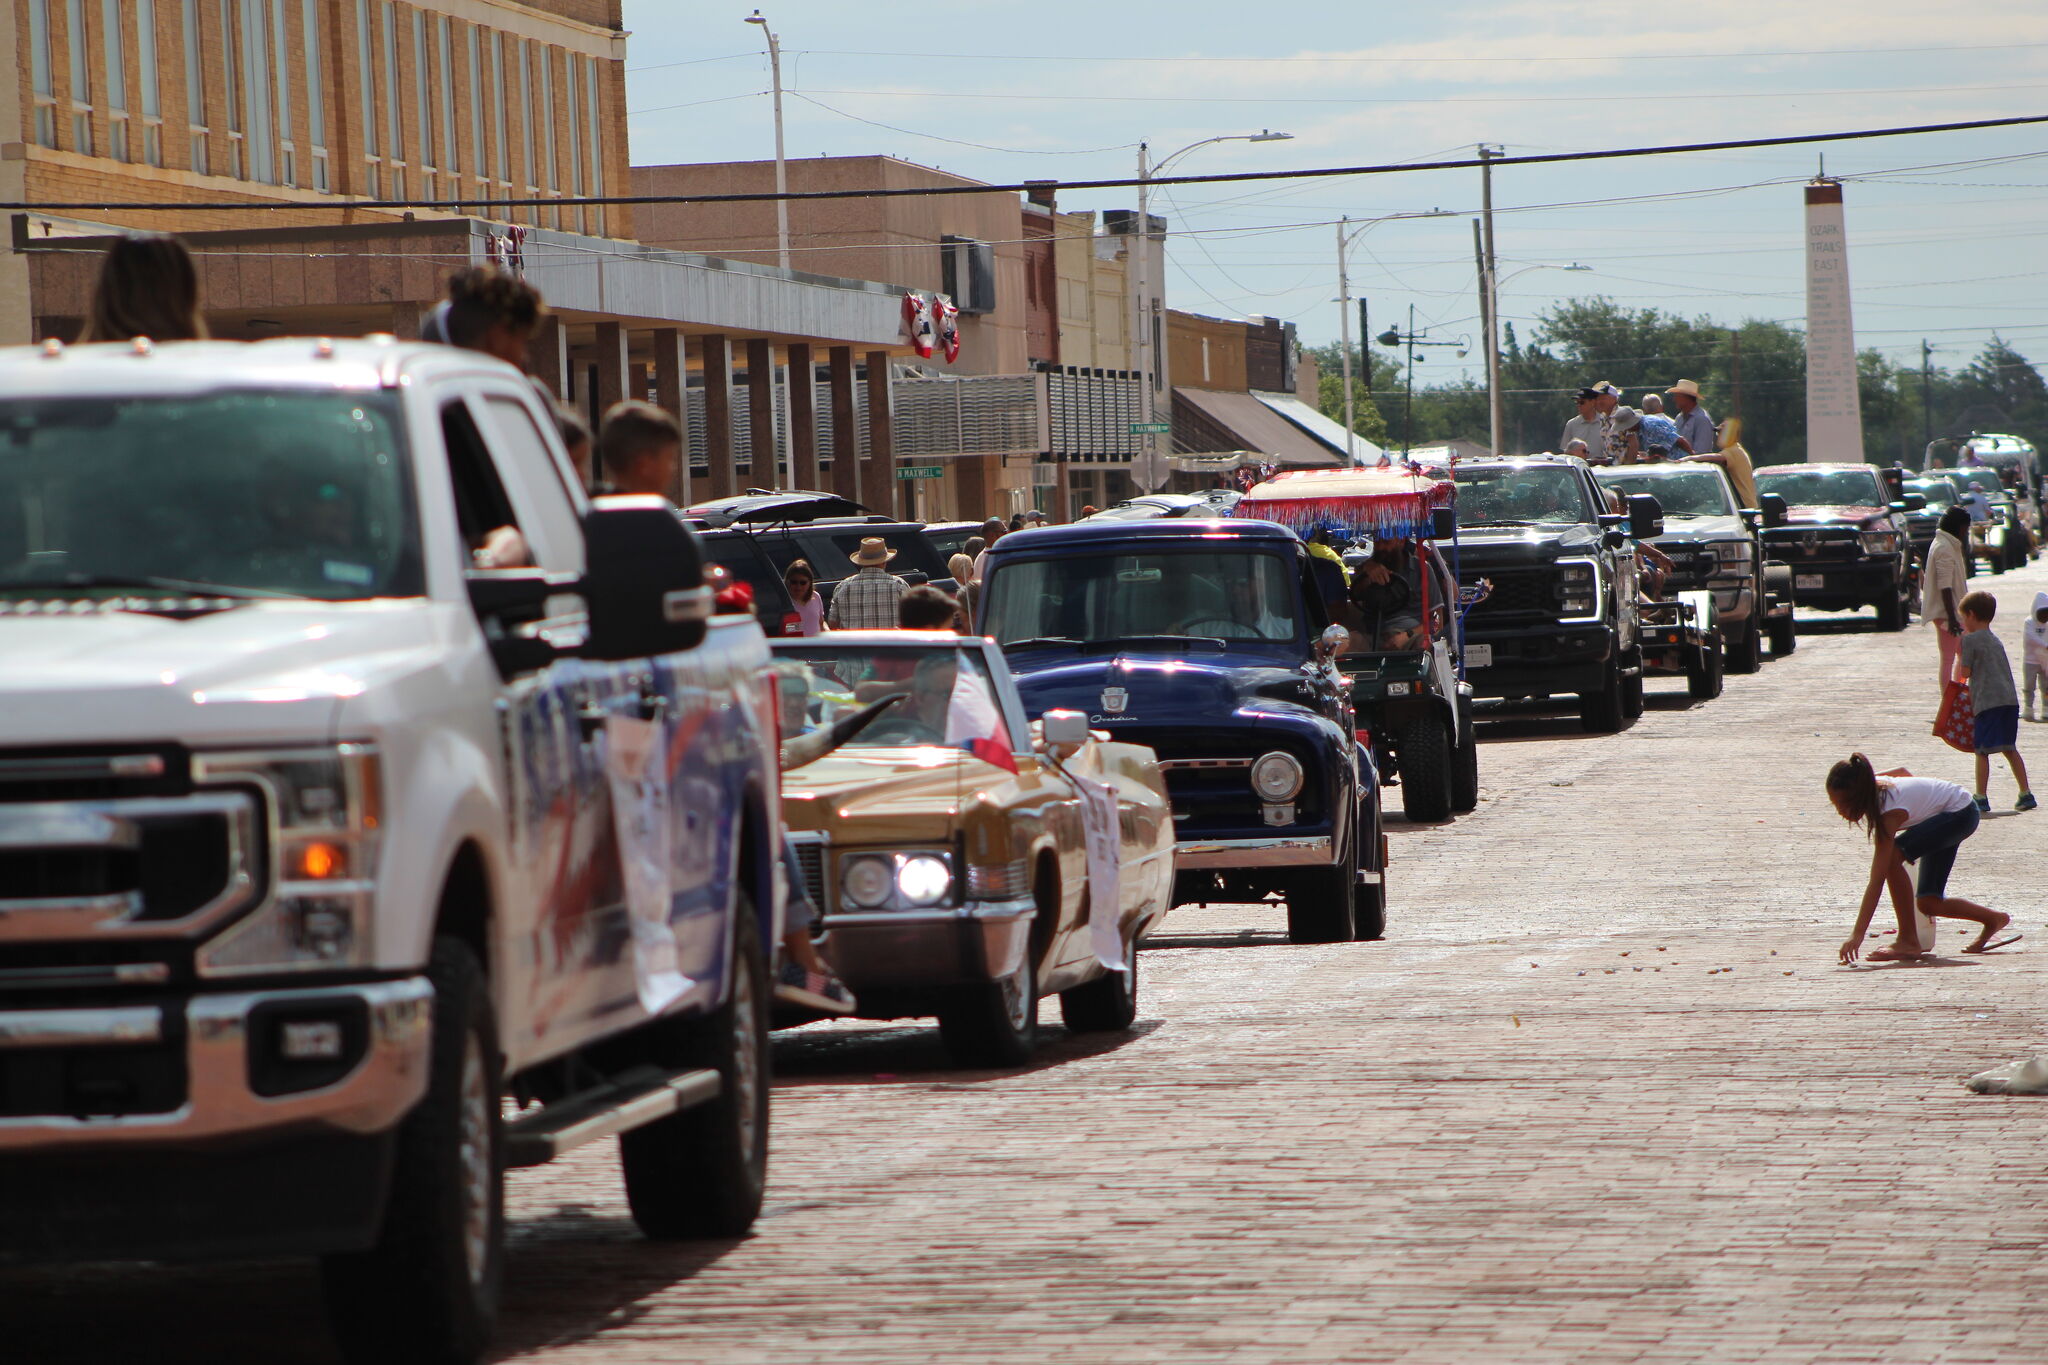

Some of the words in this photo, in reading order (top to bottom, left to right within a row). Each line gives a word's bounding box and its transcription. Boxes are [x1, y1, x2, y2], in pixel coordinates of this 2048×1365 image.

[1810, 225, 1839, 236] OZARK
[1810, 242, 1841, 253] TRAILS
[1814, 259, 1839, 271] EAST
[904, 469, 934, 478] MAXWELL
